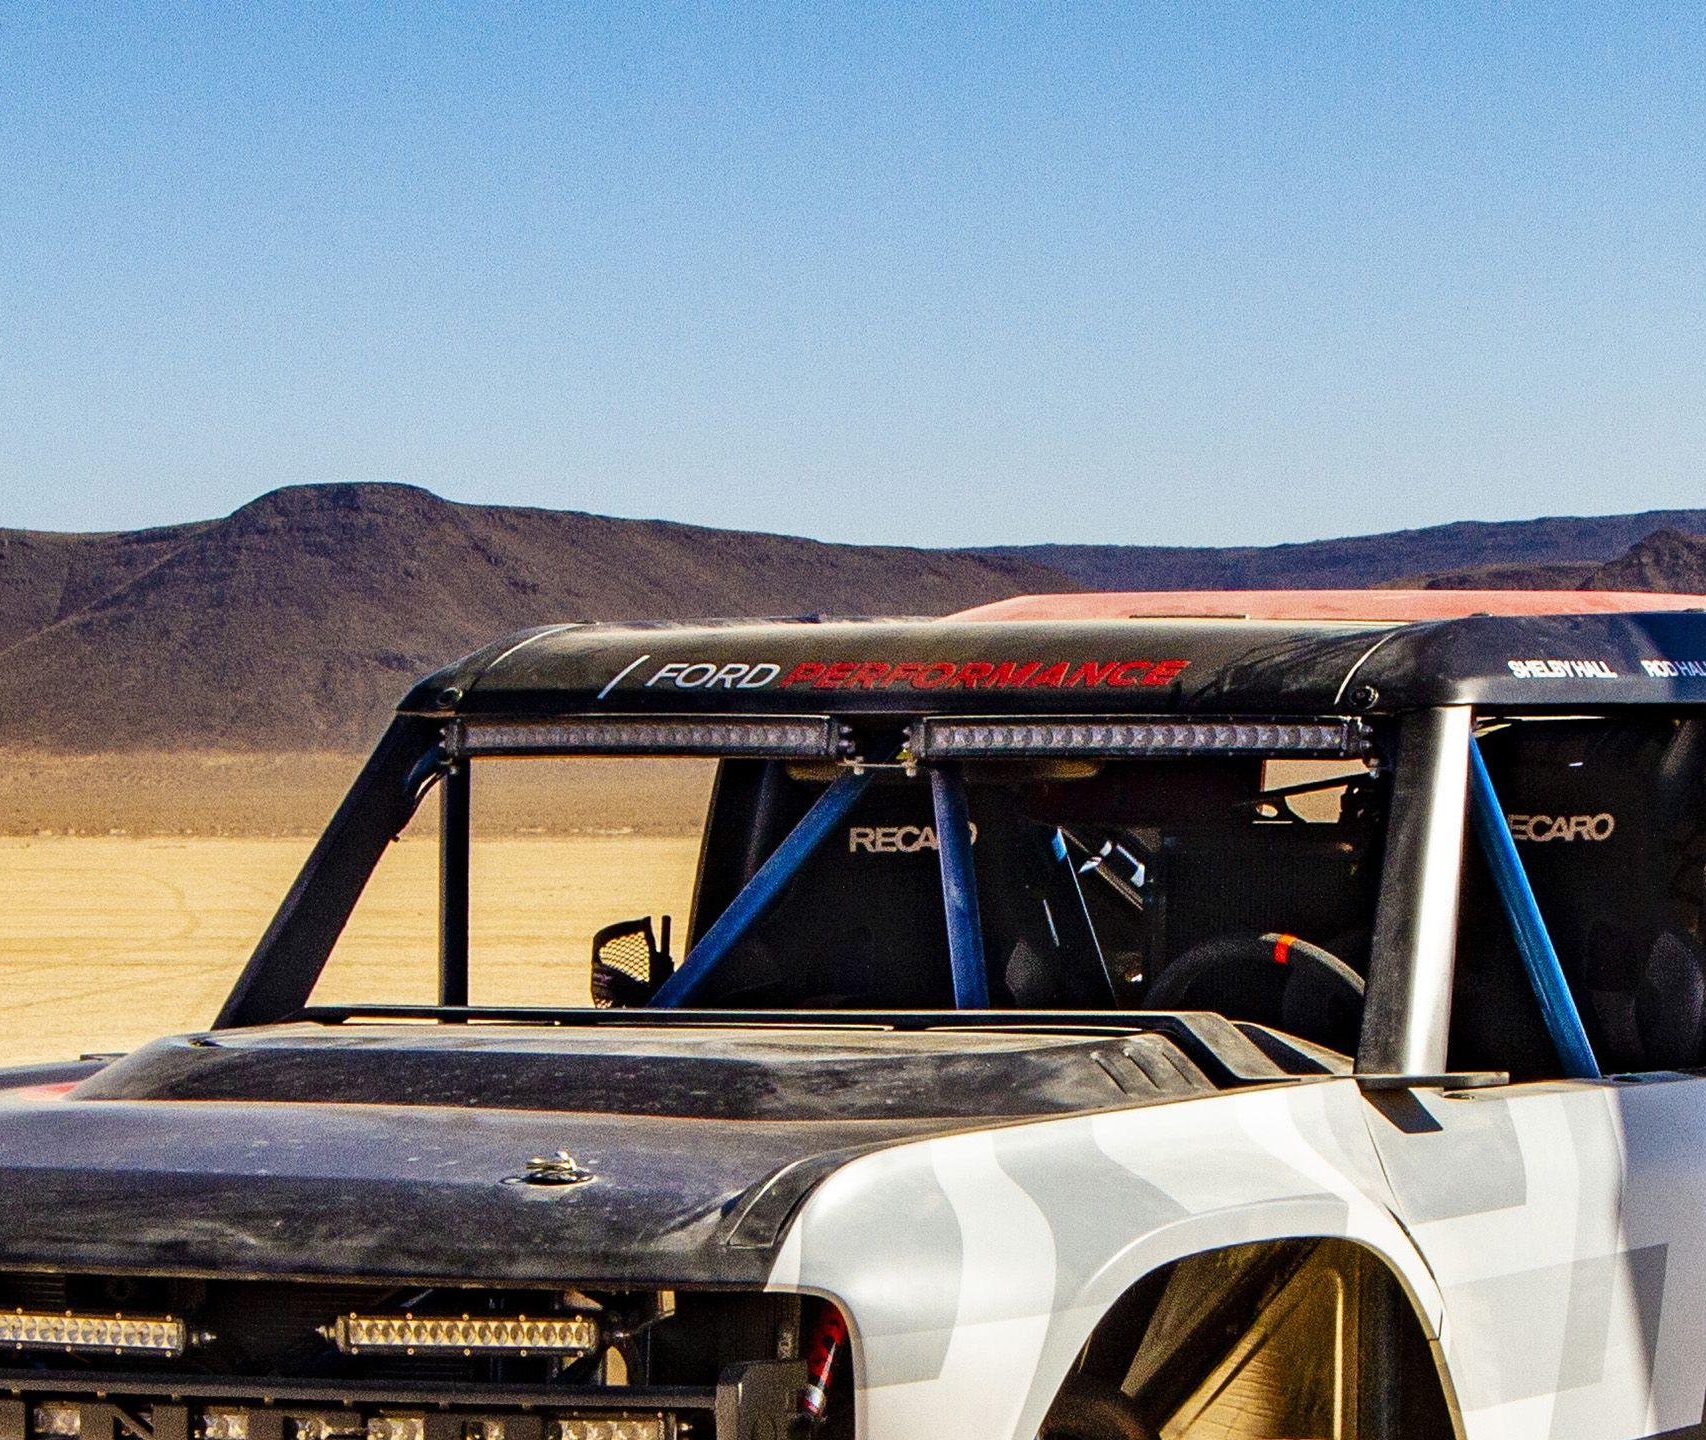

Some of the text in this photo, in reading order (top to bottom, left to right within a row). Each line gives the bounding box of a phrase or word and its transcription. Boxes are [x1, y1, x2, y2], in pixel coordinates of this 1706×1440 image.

[647, 659, 1191, 690] FORD PERFORMANCE
[1508, 659, 1618, 679] SHELBY HALL
[1640, 660, 1679, 677] ROD
[849, 821, 978, 853] RECA
[1507, 812, 1616, 842] ECARO
